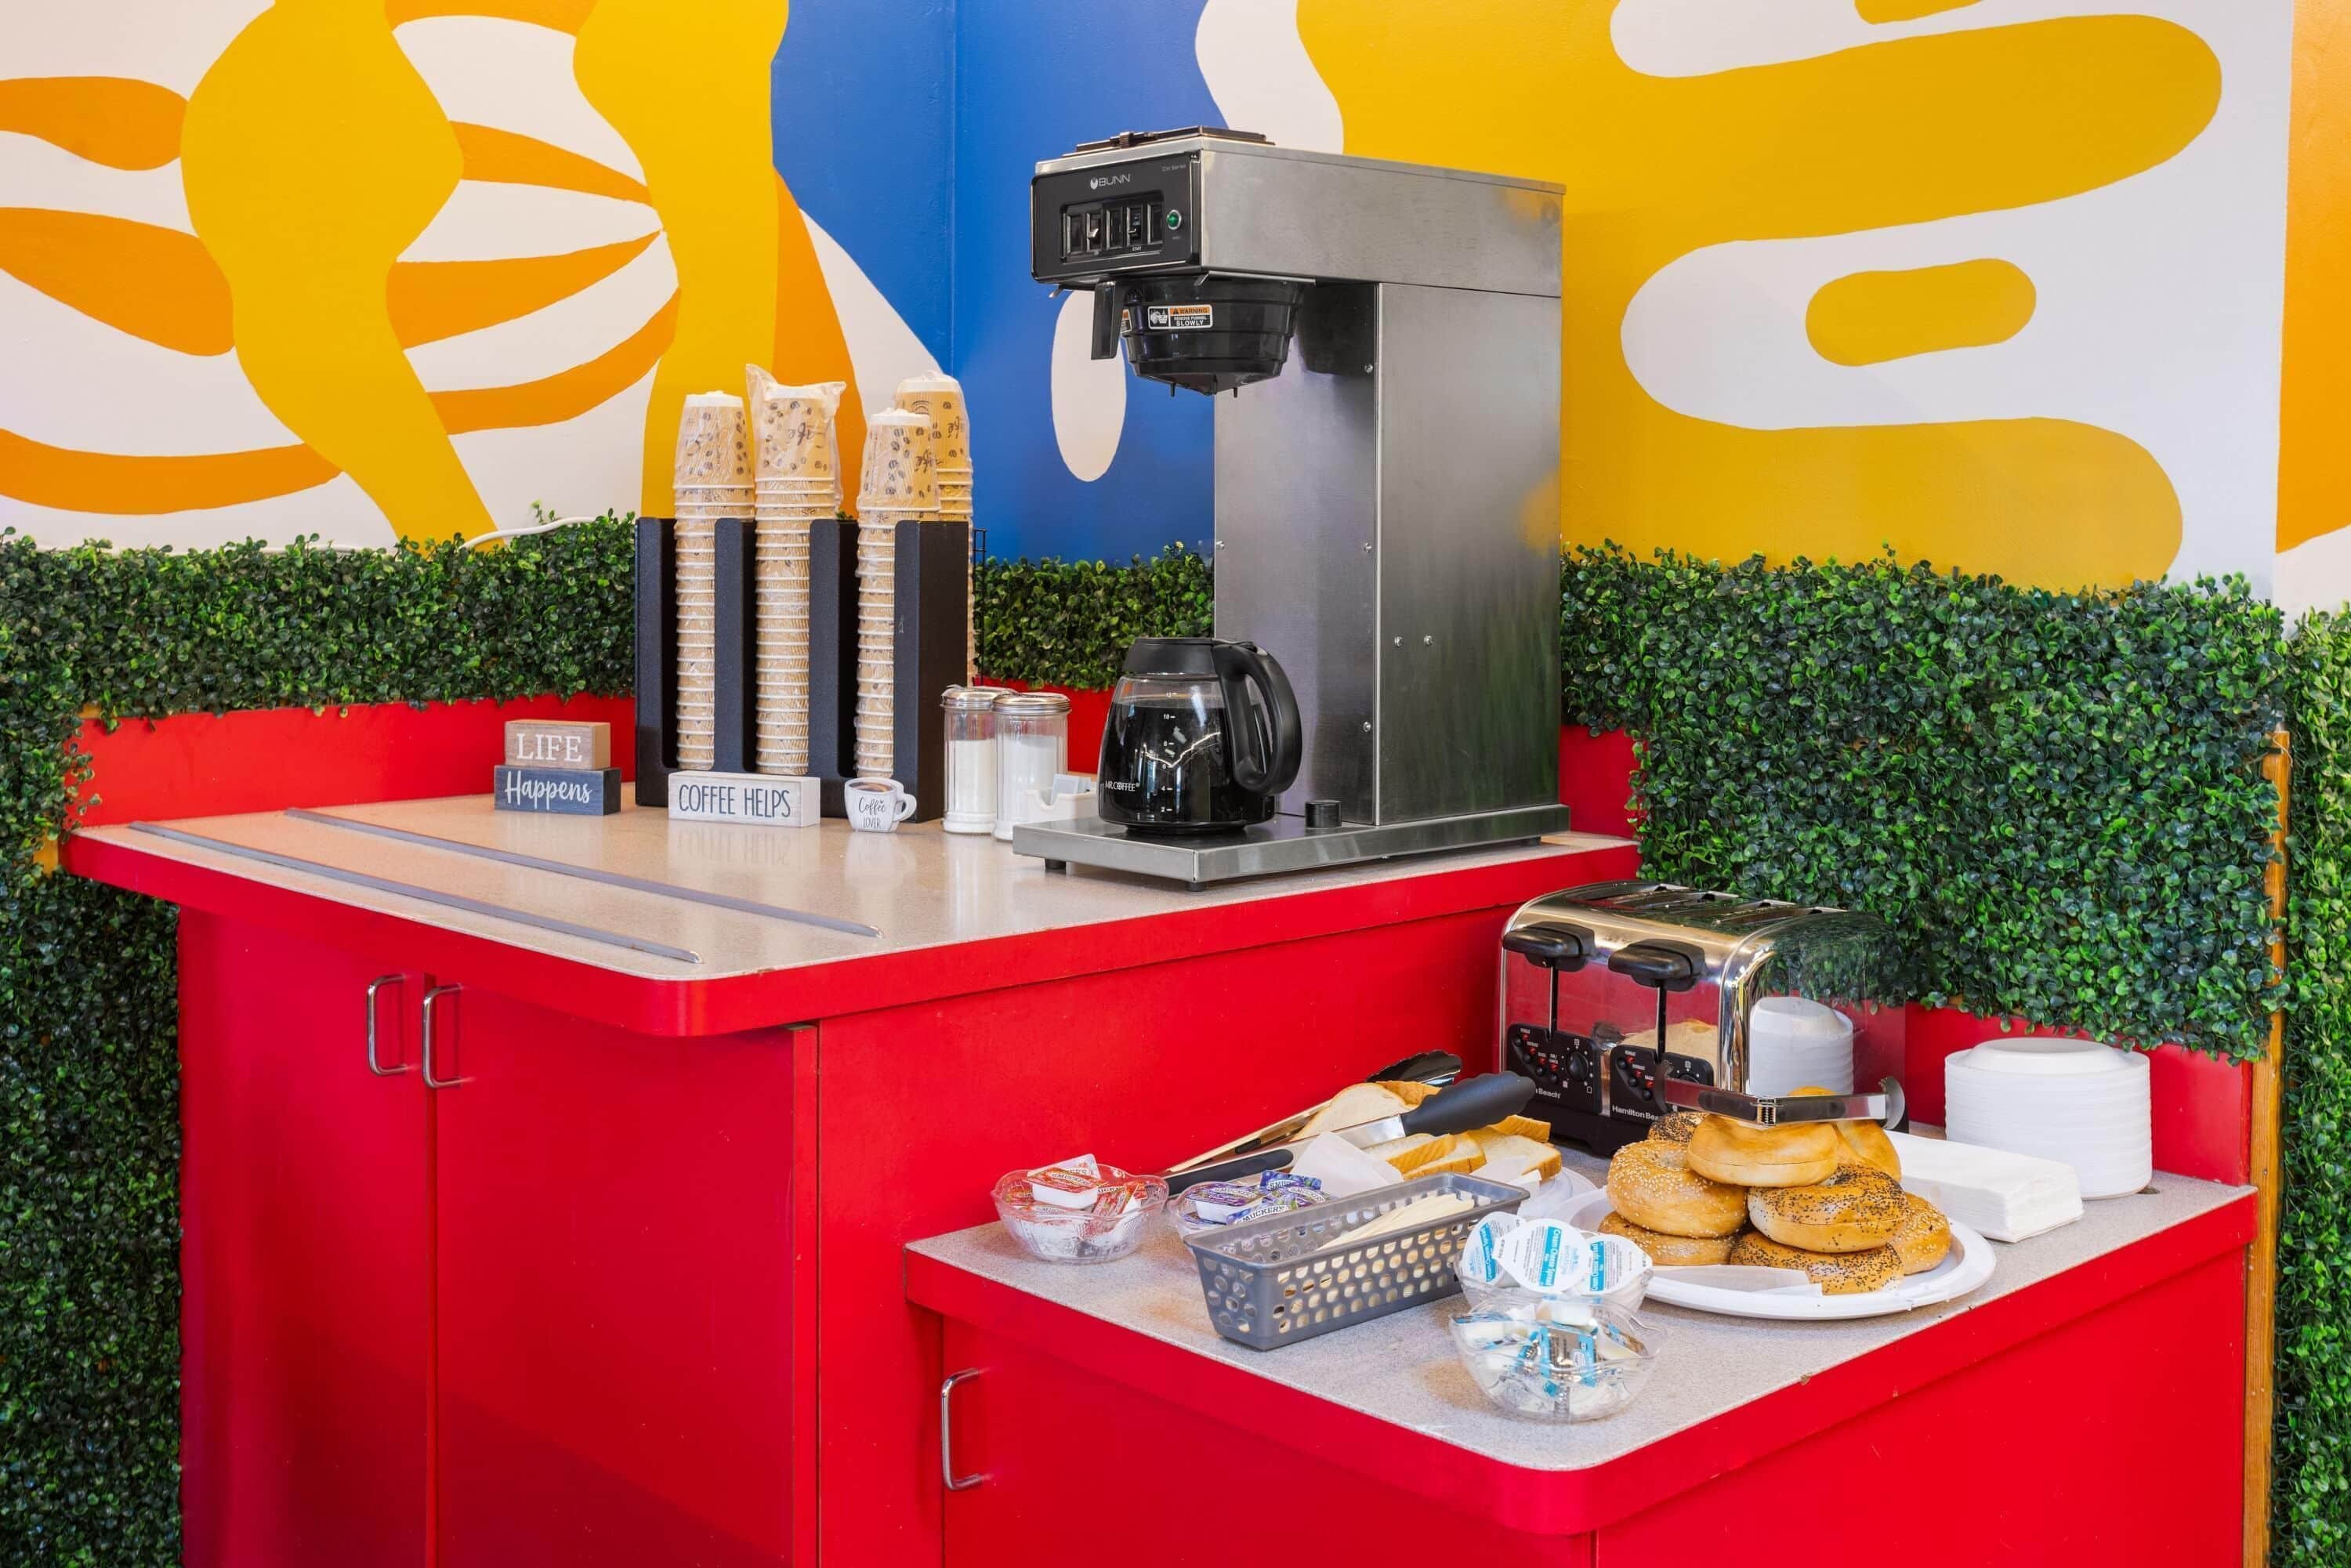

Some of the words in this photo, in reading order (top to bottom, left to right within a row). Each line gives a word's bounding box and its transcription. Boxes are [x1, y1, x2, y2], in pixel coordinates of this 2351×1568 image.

[1099, 174, 1130, 186] BUNN
[516, 733, 582, 762] LIFE
[505, 770, 592, 810] Happens
[679, 784, 736, 815] COFFEE
[744, 788, 791, 817] HELPS
[858, 796, 885, 816] Coffee
[863, 817, 882, 828] LOVER
[1538, 1088, 1559, 1099] Beach
[1612, 1104, 1645, 1119] Hamilton
[1645, 1112, 1659, 1121] Bea
[1552, 1229, 1561, 1248] Cream
[1548, 1248, 1559, 1268] Cheese
